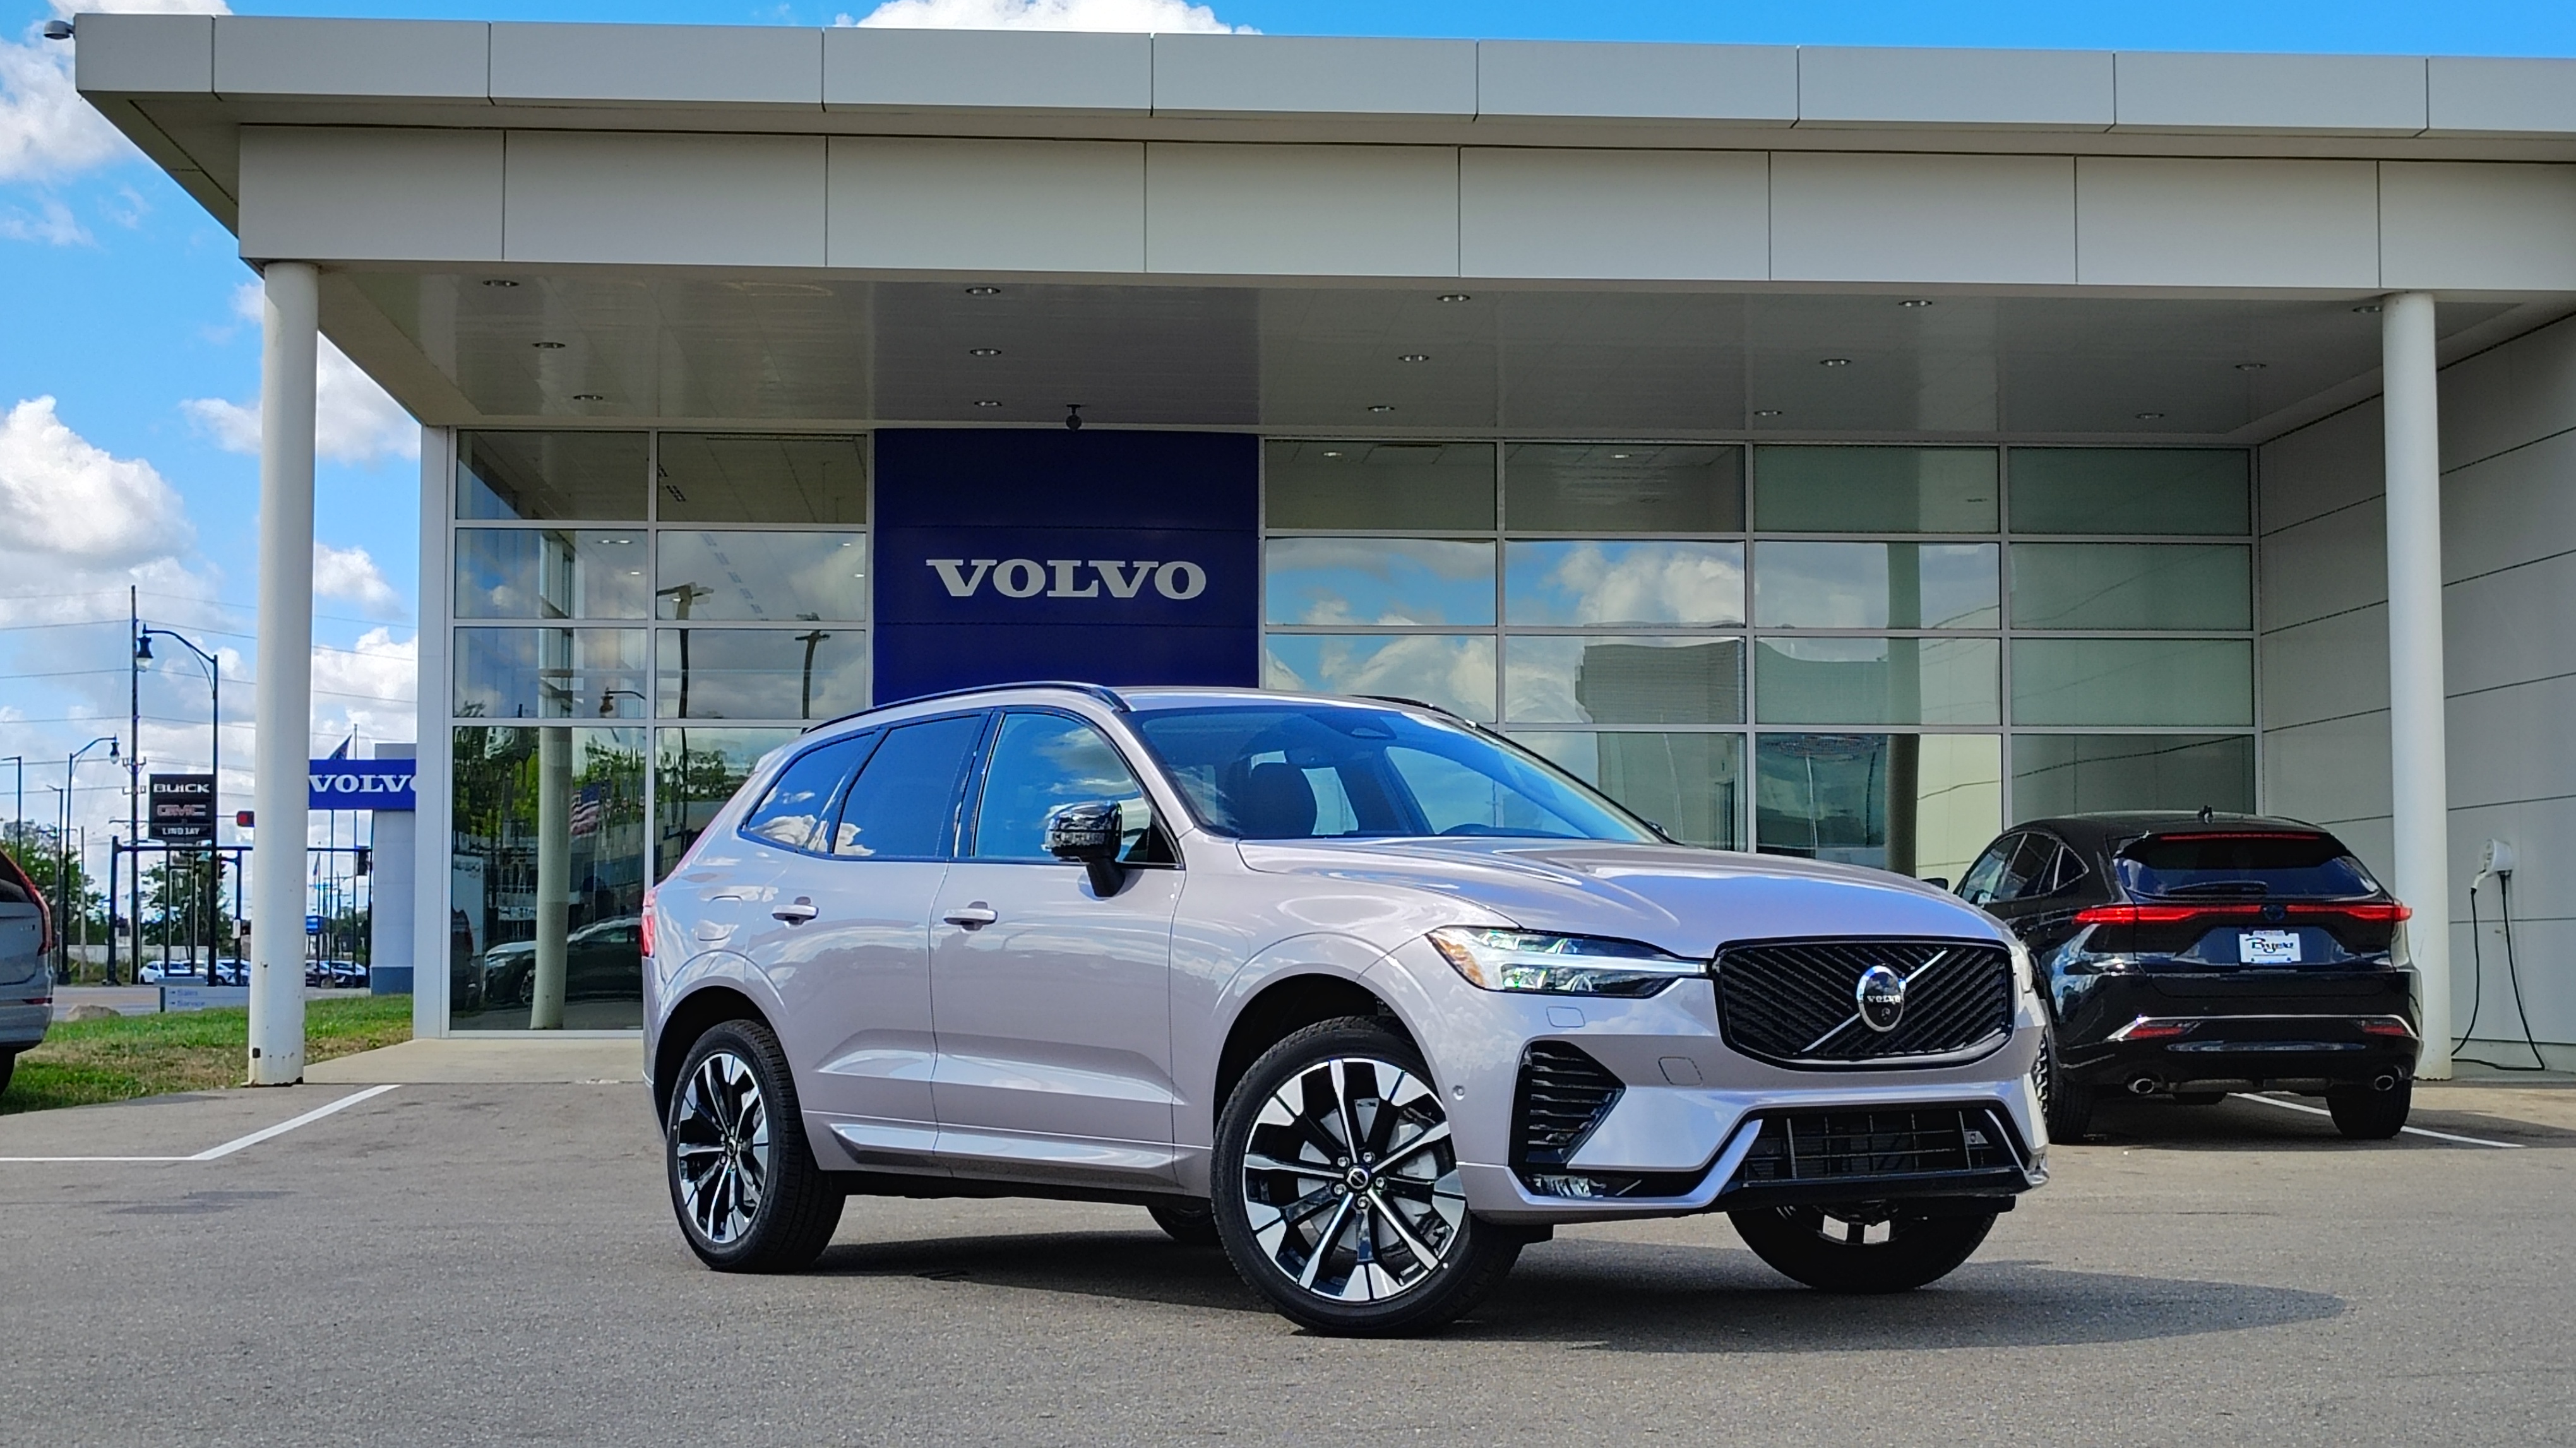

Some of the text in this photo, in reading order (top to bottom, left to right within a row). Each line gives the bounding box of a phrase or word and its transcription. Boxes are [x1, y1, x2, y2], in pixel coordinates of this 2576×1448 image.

[926, 559, 1207, 600] VOLVO
[153, 783, 210, 793] BUICK
[308, 774, 416, 793] VOLV
[157, 804, 206, 816] GMC
